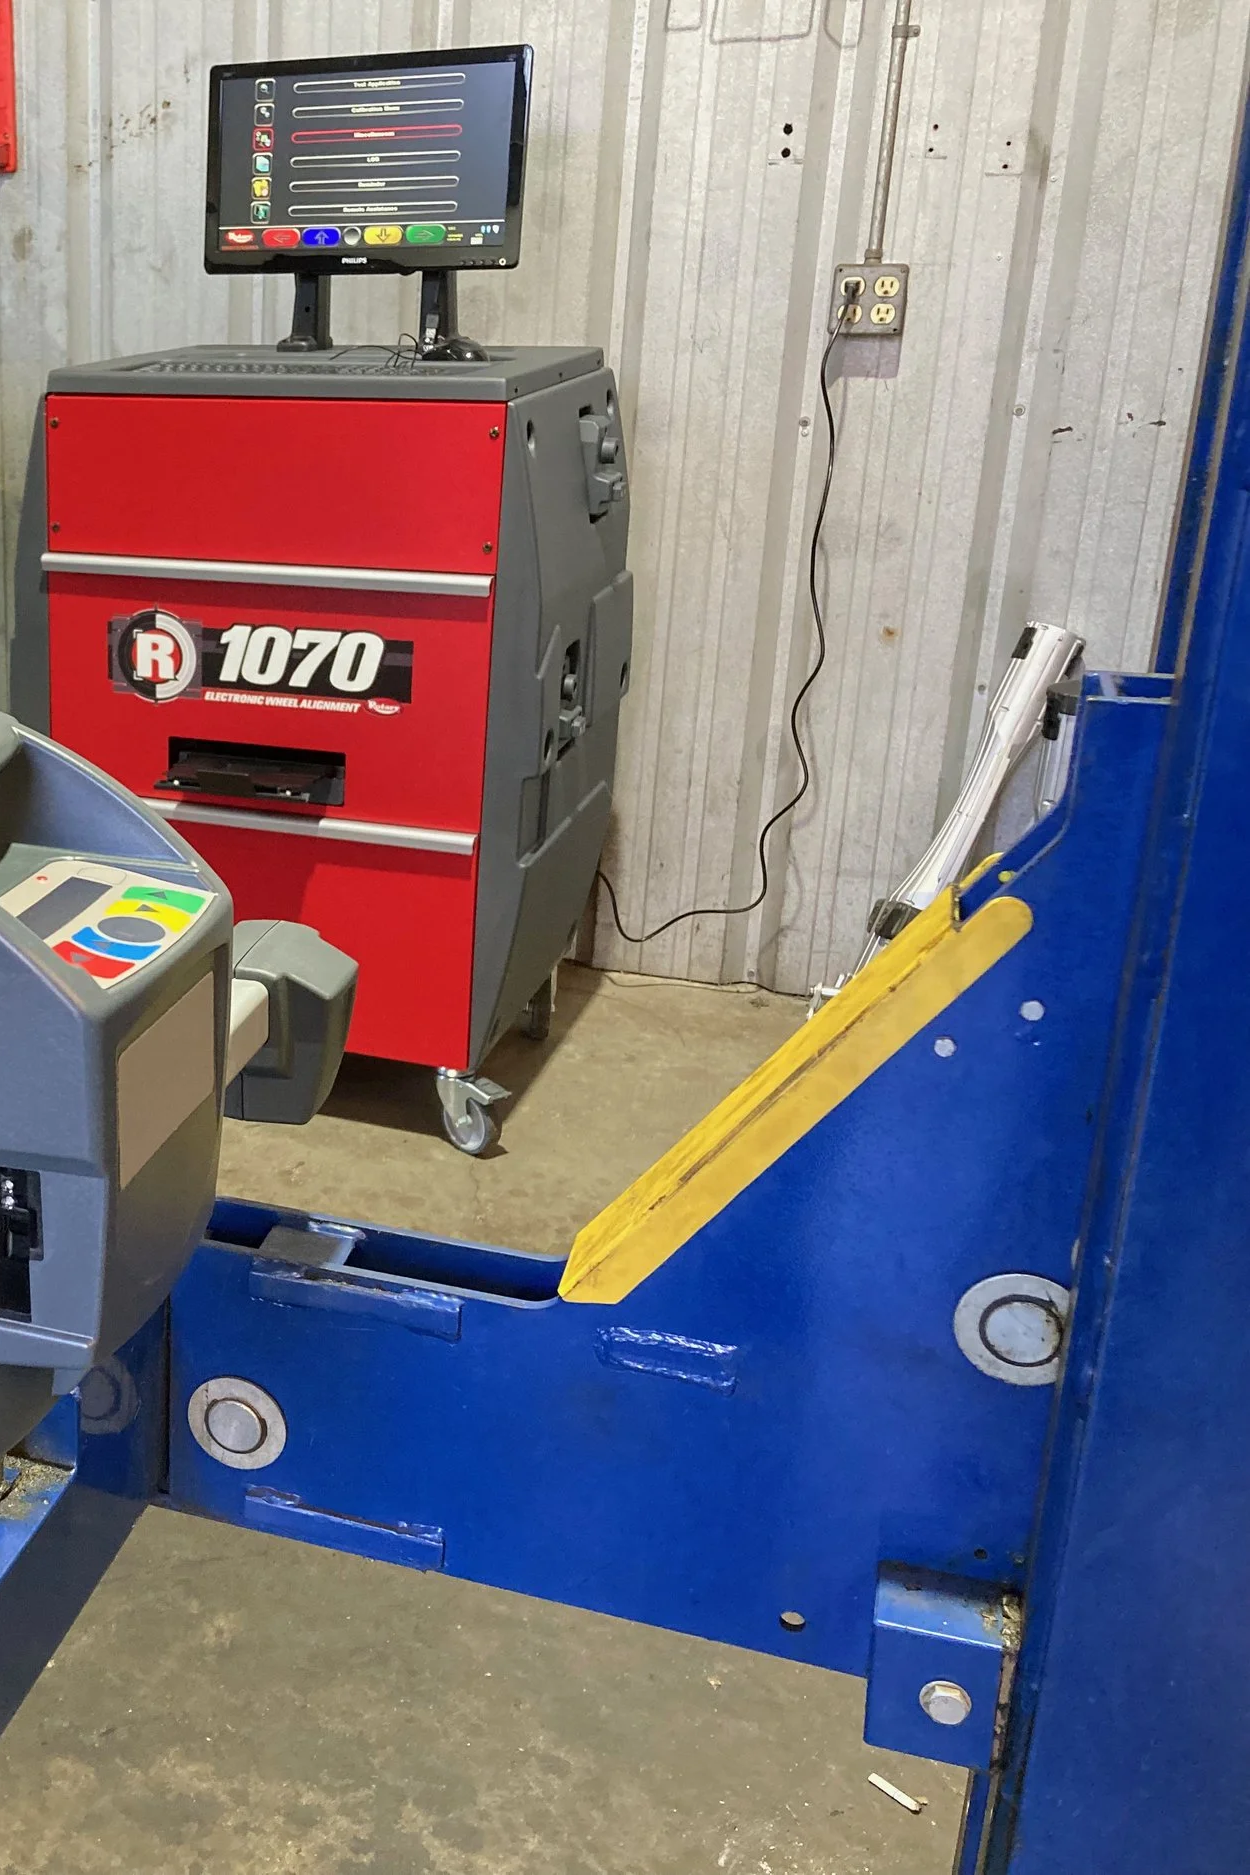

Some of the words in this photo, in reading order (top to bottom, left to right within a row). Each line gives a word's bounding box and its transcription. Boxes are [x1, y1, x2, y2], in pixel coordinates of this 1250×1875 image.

[135, 632, 179, 681] R
[218, 624, 385, 693] 1070
[204, 691, 264, 706] ELECTRONIC
[264, 696, 299, 709] WHEEL
[299, 698, 361, 713] ALIGNMENT
[367, 700, 400, 715] Rotary
